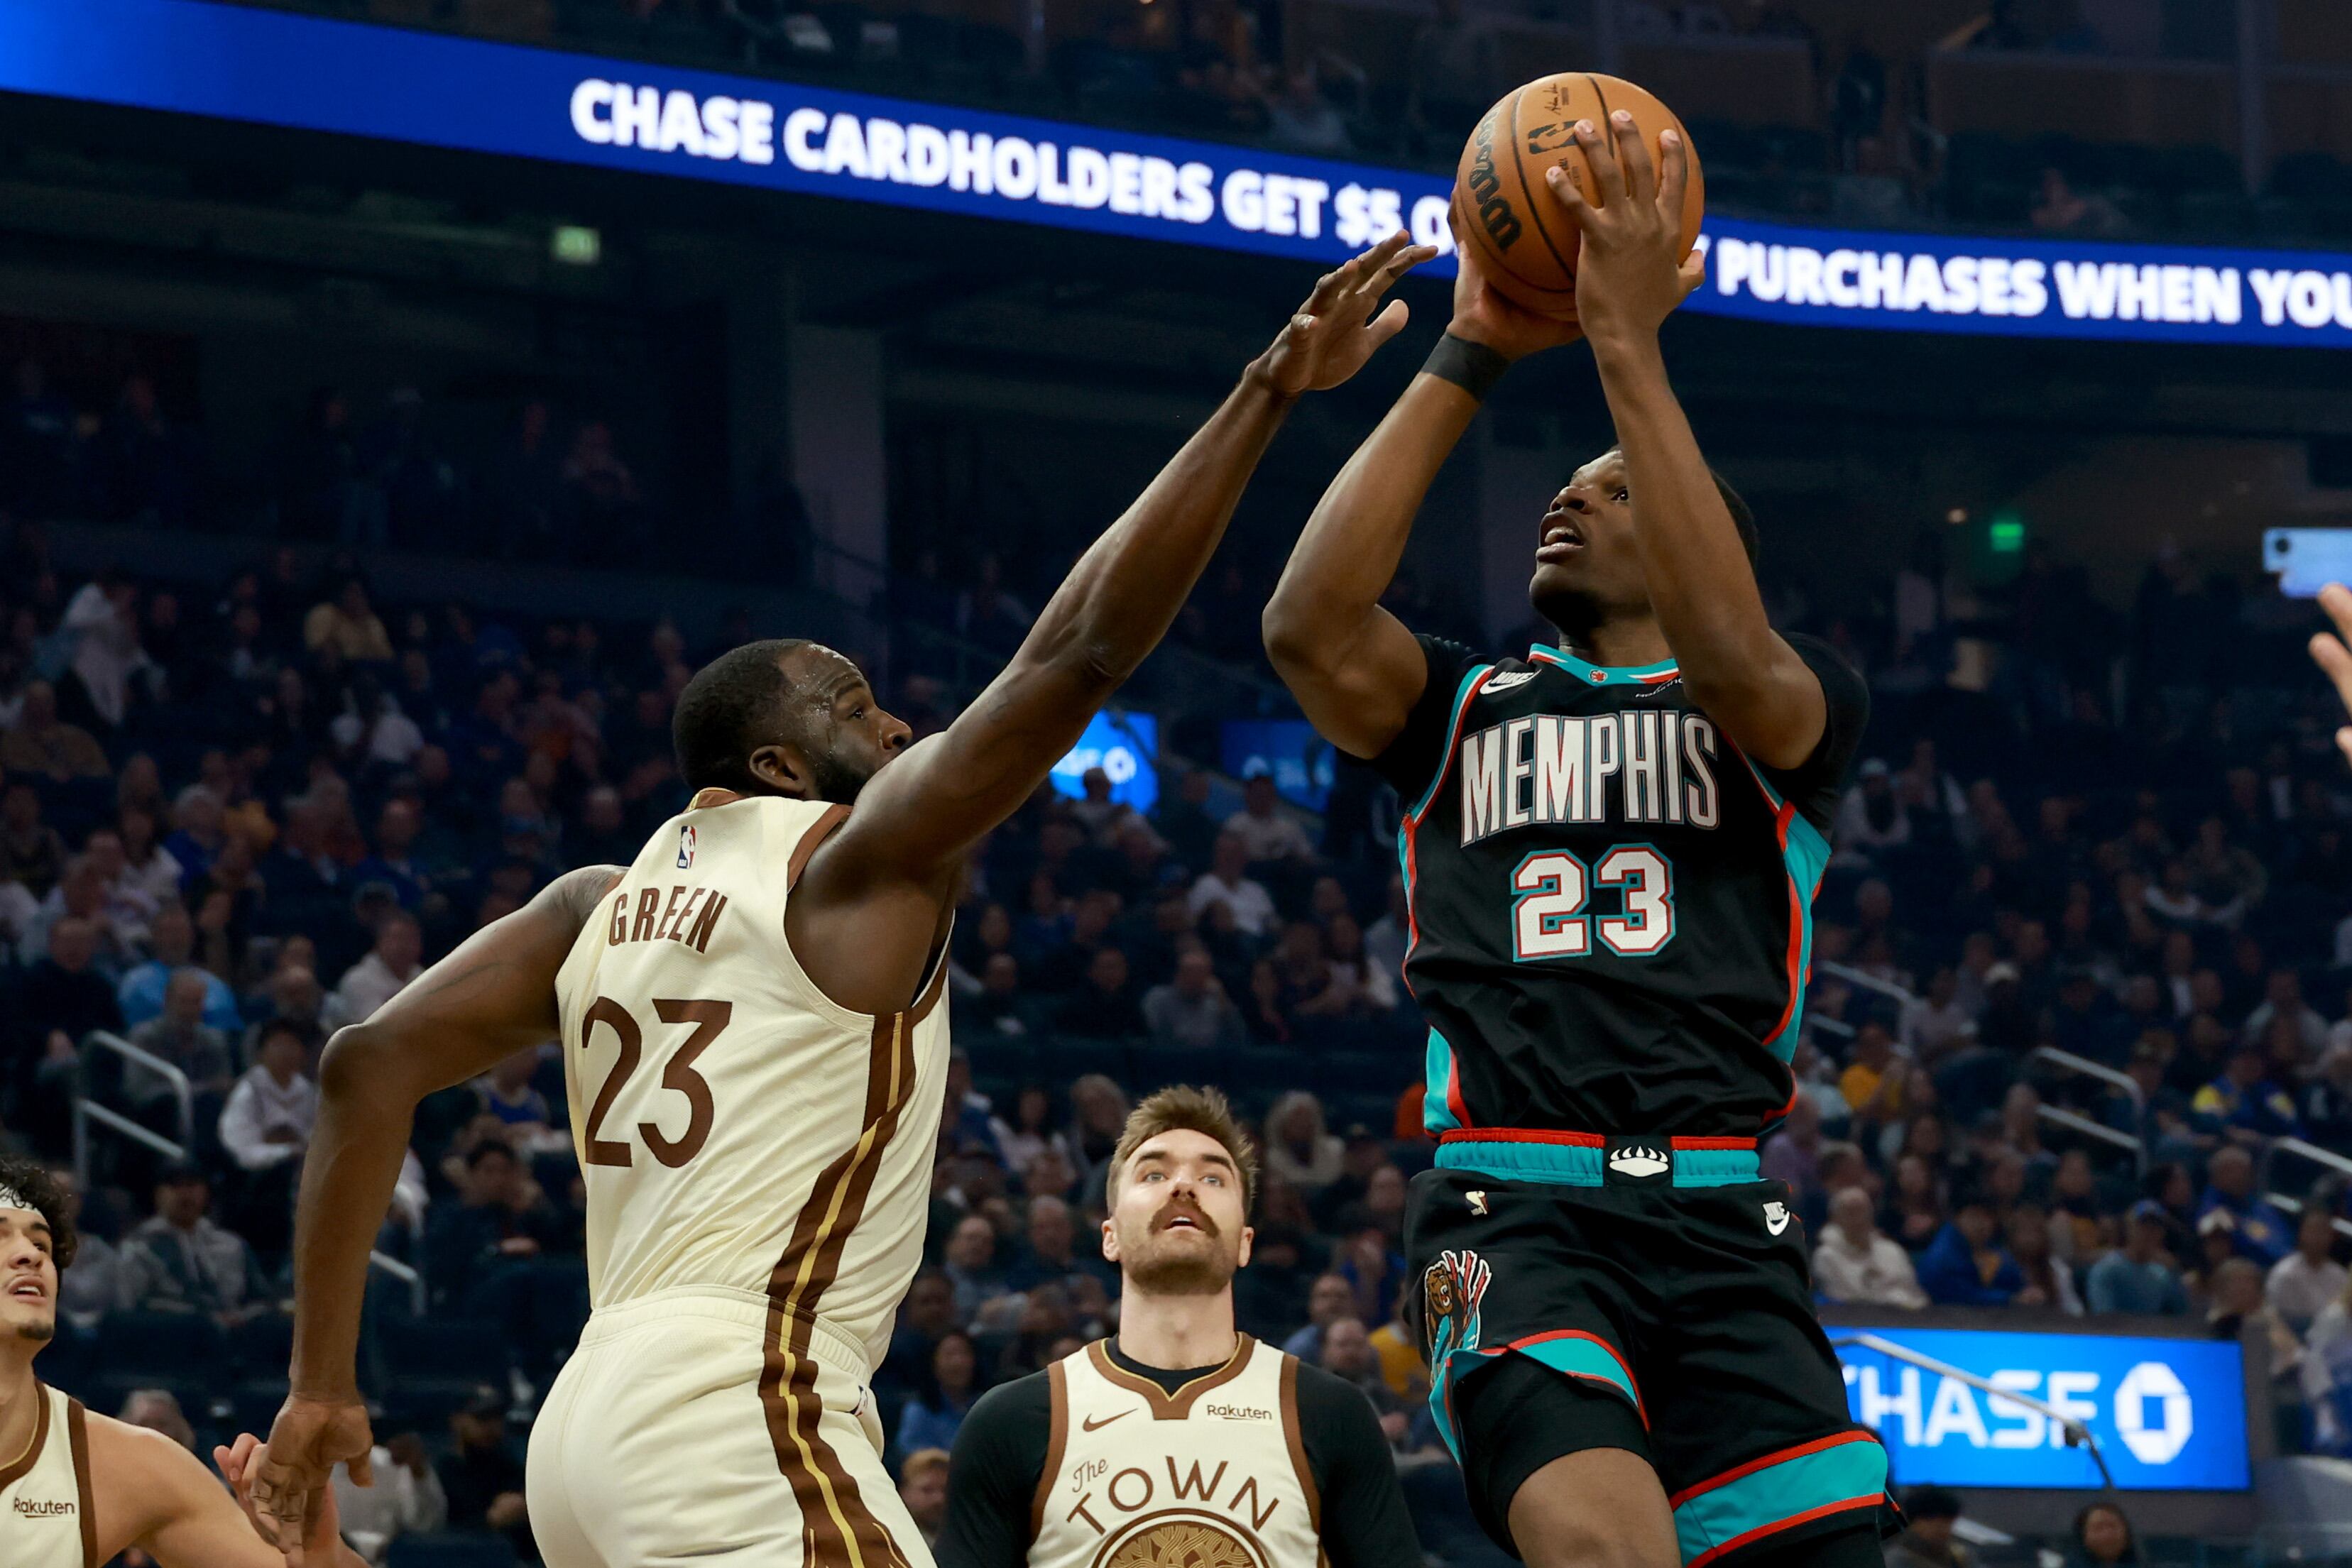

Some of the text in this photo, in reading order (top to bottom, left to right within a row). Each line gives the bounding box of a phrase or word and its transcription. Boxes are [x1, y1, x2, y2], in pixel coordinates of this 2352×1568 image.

[570, 79, 774, 165] CHASE
[783, 108, 1215, 224] CARDHOLDERS
[1221, 169, 1330, 239] GET
[1334, 182, 1405, 248] $5
[1716, 238, 2048, 317] PURCHASES
[2053, 261, 2242, 324] WHEN
[1460, 710, 1720, 848] MEMPHIS
[608, 885, 728, 954] GREEN
[1510, 843, 1676, 963] 23
[581, 996, 733, 1168] 23
[1207, 1404, 1272, 1420] Rakuten
[13, 1496, 75, 1515] Rakuten
[1066, 1455, 1280, 1536] TOWN
[1072, 1457, 1109, 1493] The
